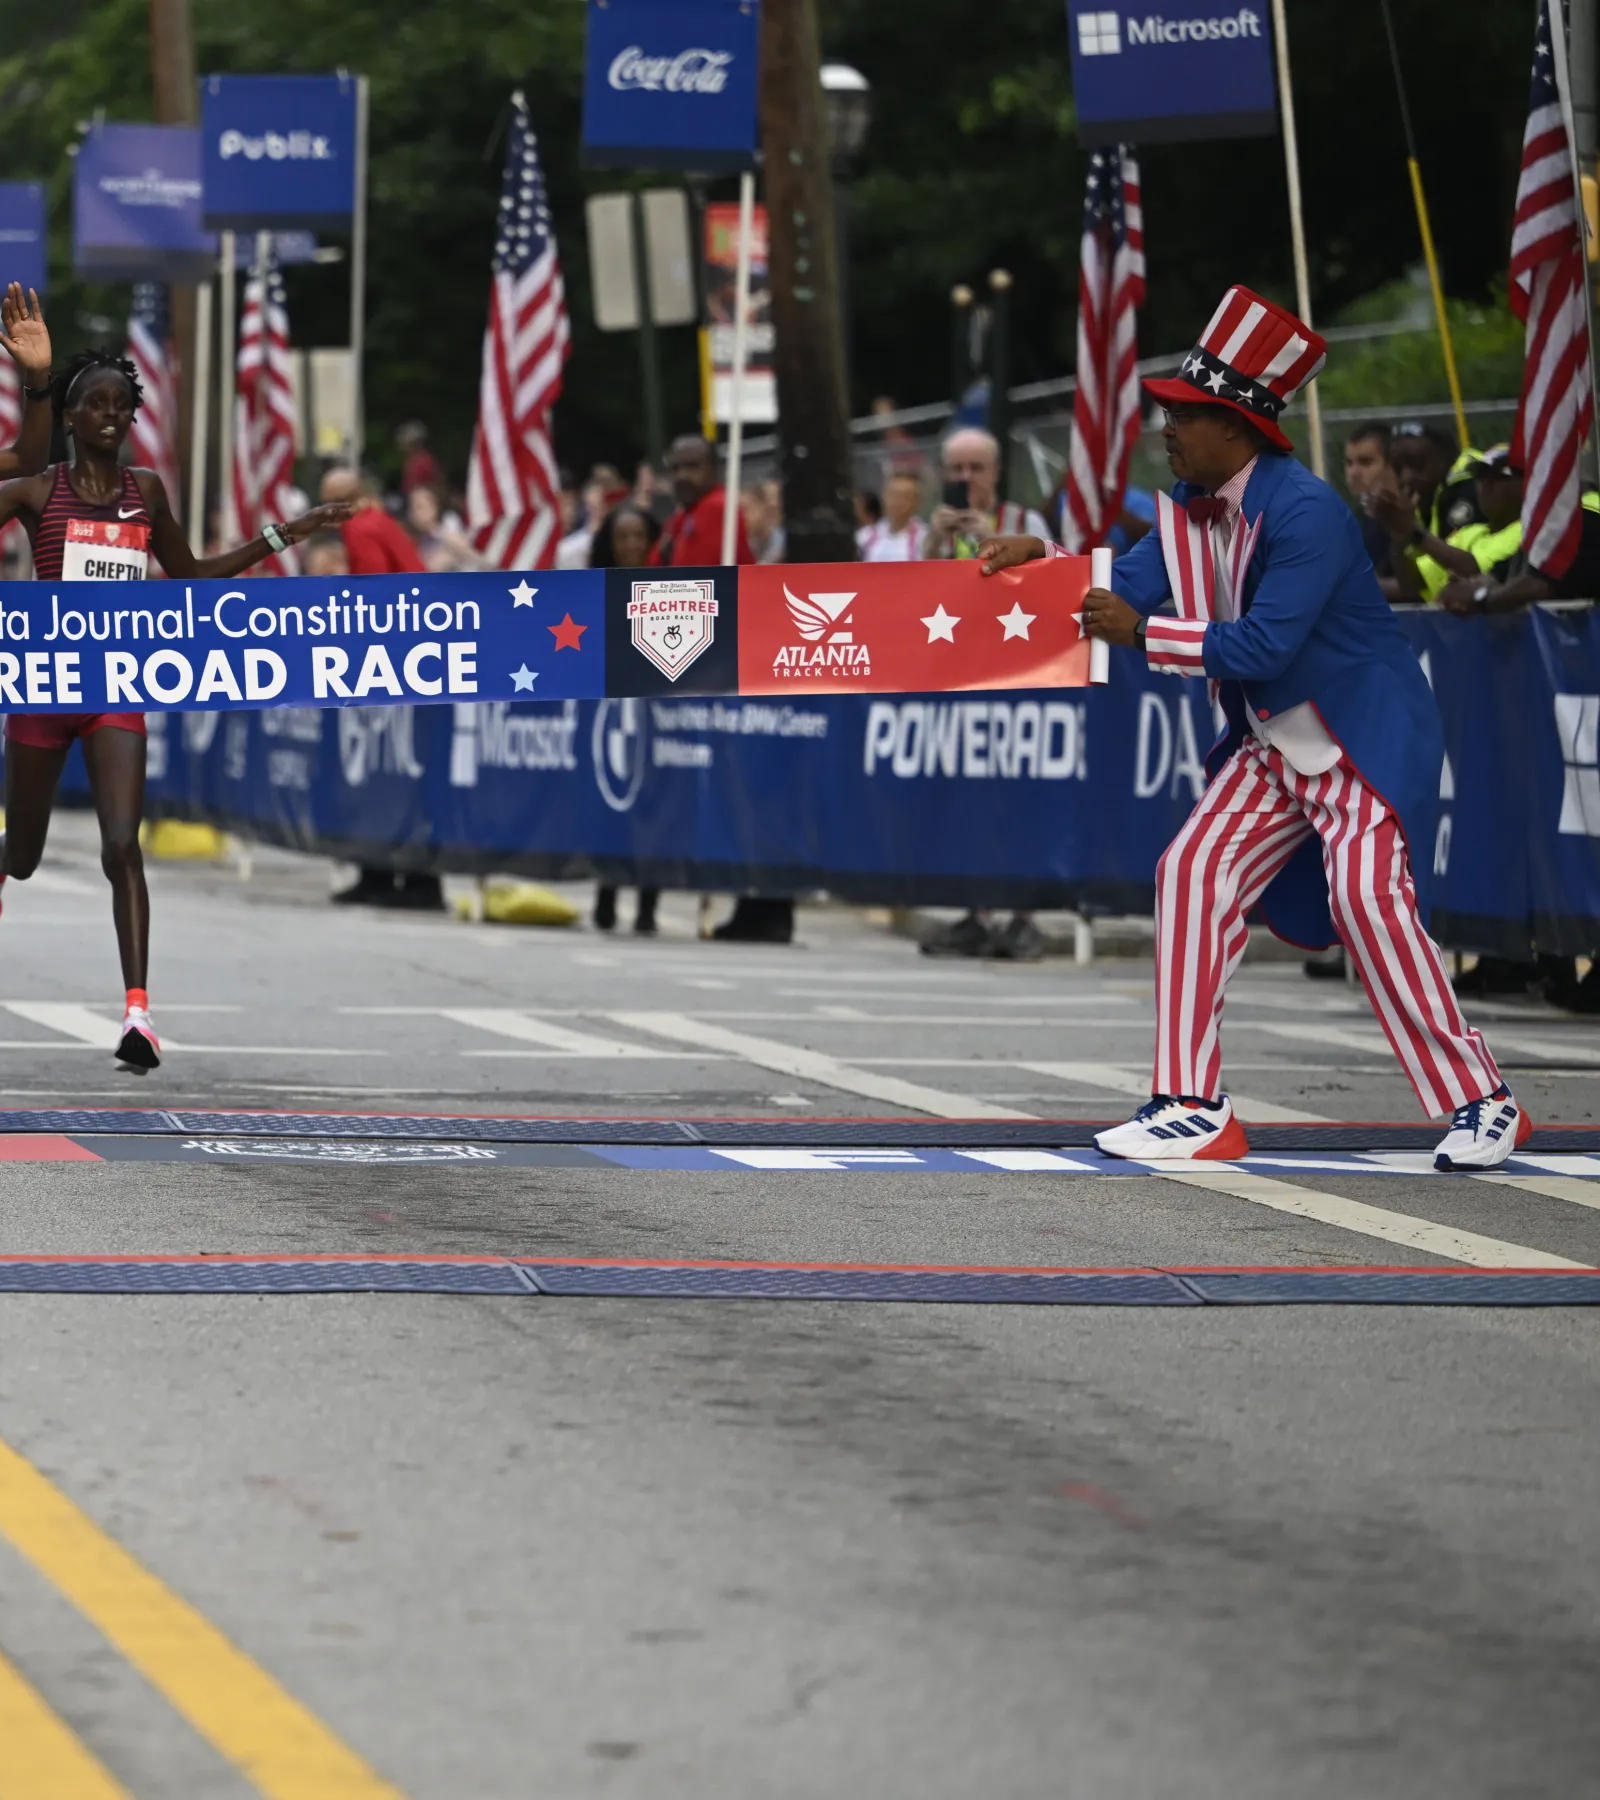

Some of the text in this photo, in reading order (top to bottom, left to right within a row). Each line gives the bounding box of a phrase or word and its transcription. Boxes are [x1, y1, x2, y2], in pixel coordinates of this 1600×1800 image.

[1127, 8, 1262, 45] Microsoft
[219, 130, 330, 161] Publix
[44, 586, 481, 641] Journal-Constitution
[629, 600, 716, 616] PEACHTREE
[105, 648, 288, 704] ROAD
[312, 641, 479, 699] RACE
[772, 644, 871, 667] ATLANTA
[773, 666, 871, 677] TRACK CLUB
[864, 702, 1087, 781] POWERAD
